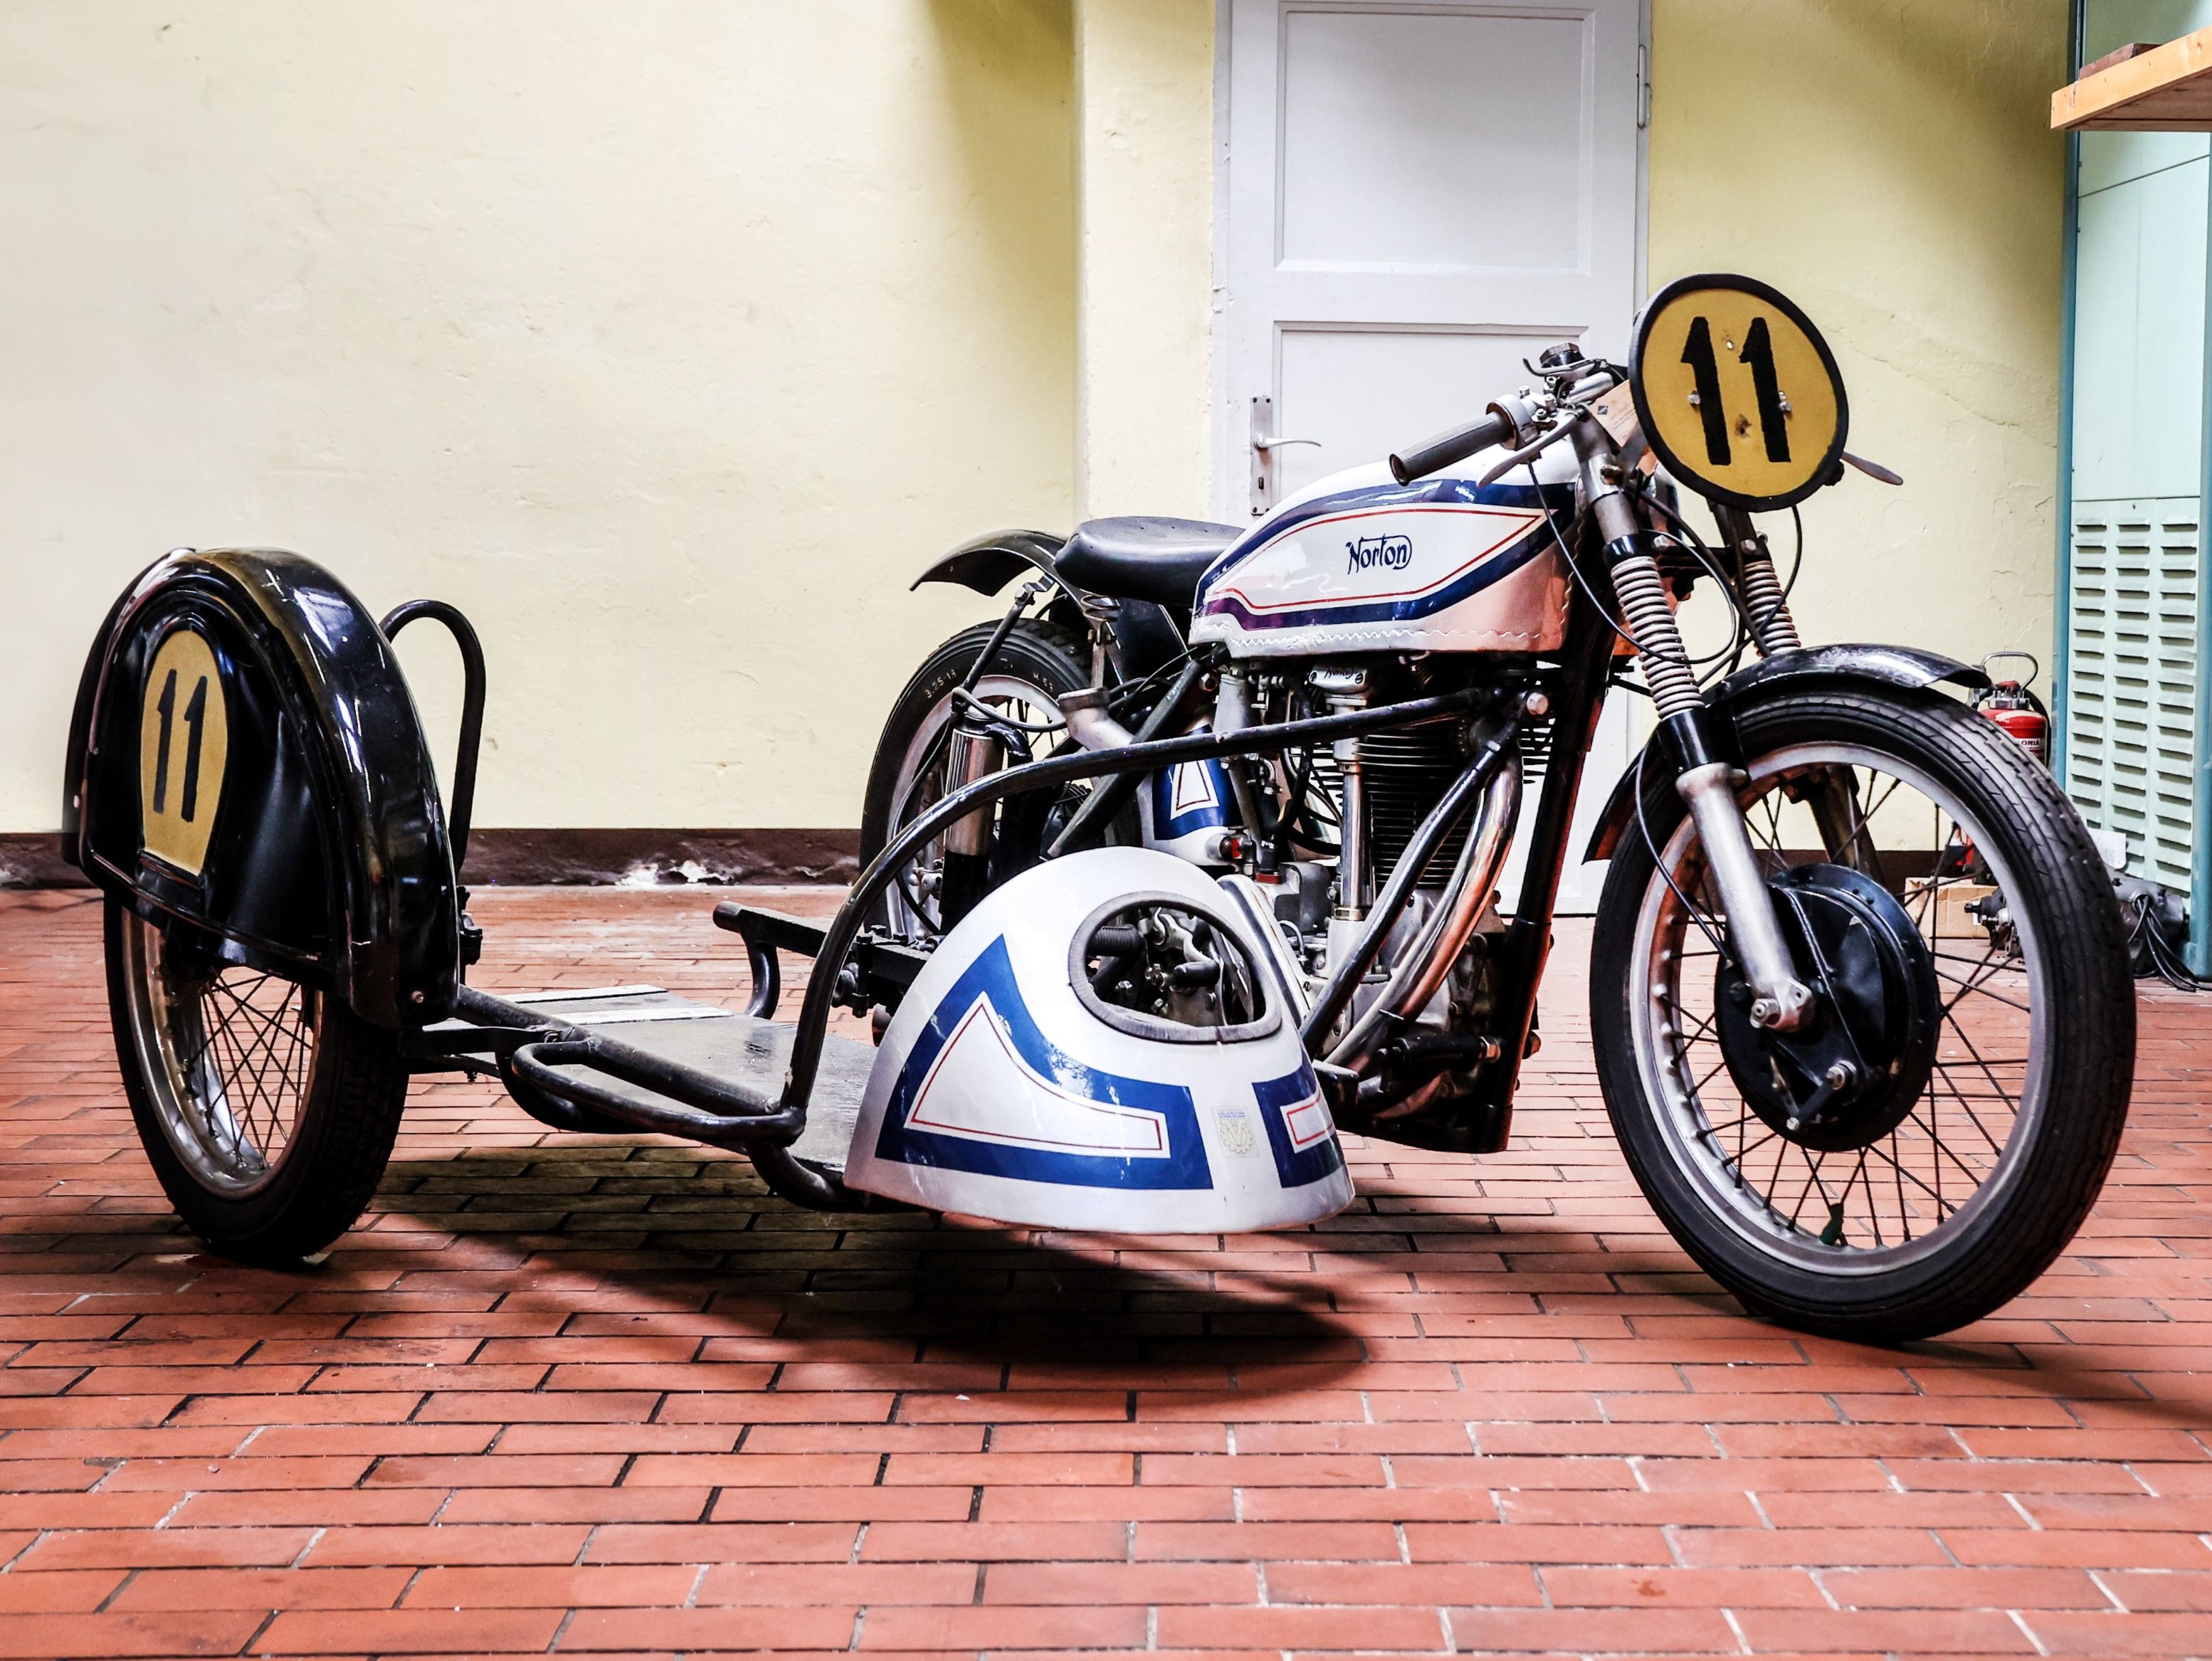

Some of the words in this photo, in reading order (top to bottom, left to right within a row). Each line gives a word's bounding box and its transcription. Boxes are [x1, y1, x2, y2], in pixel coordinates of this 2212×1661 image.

[1680, 316, 1791, 465] 11
[1345, 533, 1413, 575] Norton
[152, 668, 208, 823] 11
